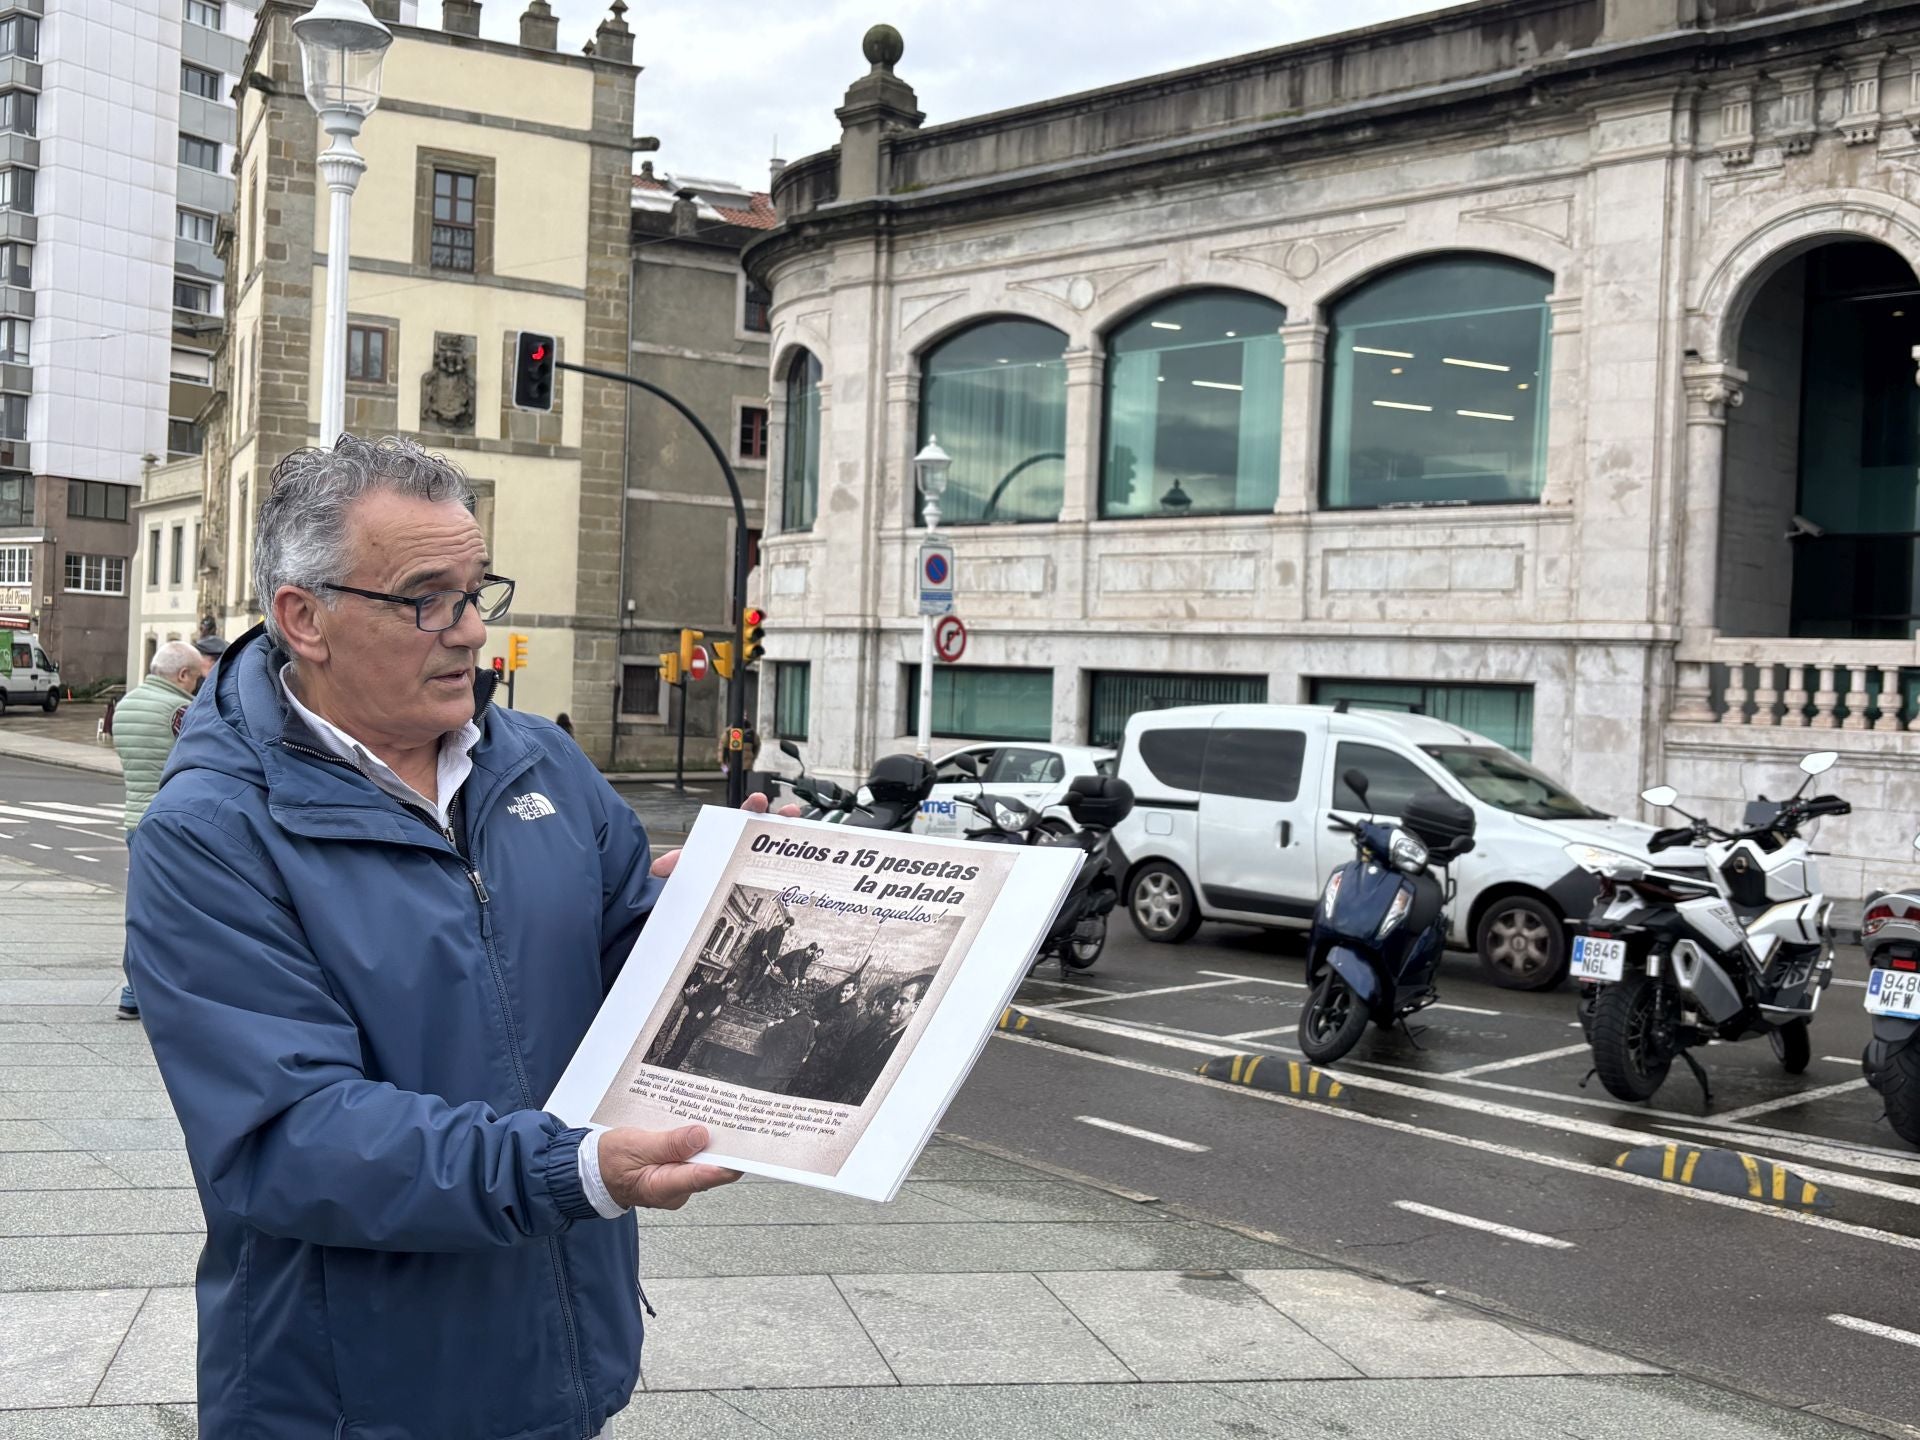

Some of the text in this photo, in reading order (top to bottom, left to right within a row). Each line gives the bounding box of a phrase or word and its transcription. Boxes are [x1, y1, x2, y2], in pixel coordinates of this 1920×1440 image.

[507, 800, 537, 815] NORTH
[513, 793, 533, 805] THE
[520, 809, 542, 821] FACE
[750, 834, 980, 882] Oricios a 15 pesetas
[853, 874, 966, 905] la palada
[772, 885, 815, 908] ¡Qué
[815, 892, 869, 917] tiempos
[1584, 941, 1620, 960] 6846
[1582, 958, 1608, 975] NGL
[1880, 990, 1915, 1009] MFW
